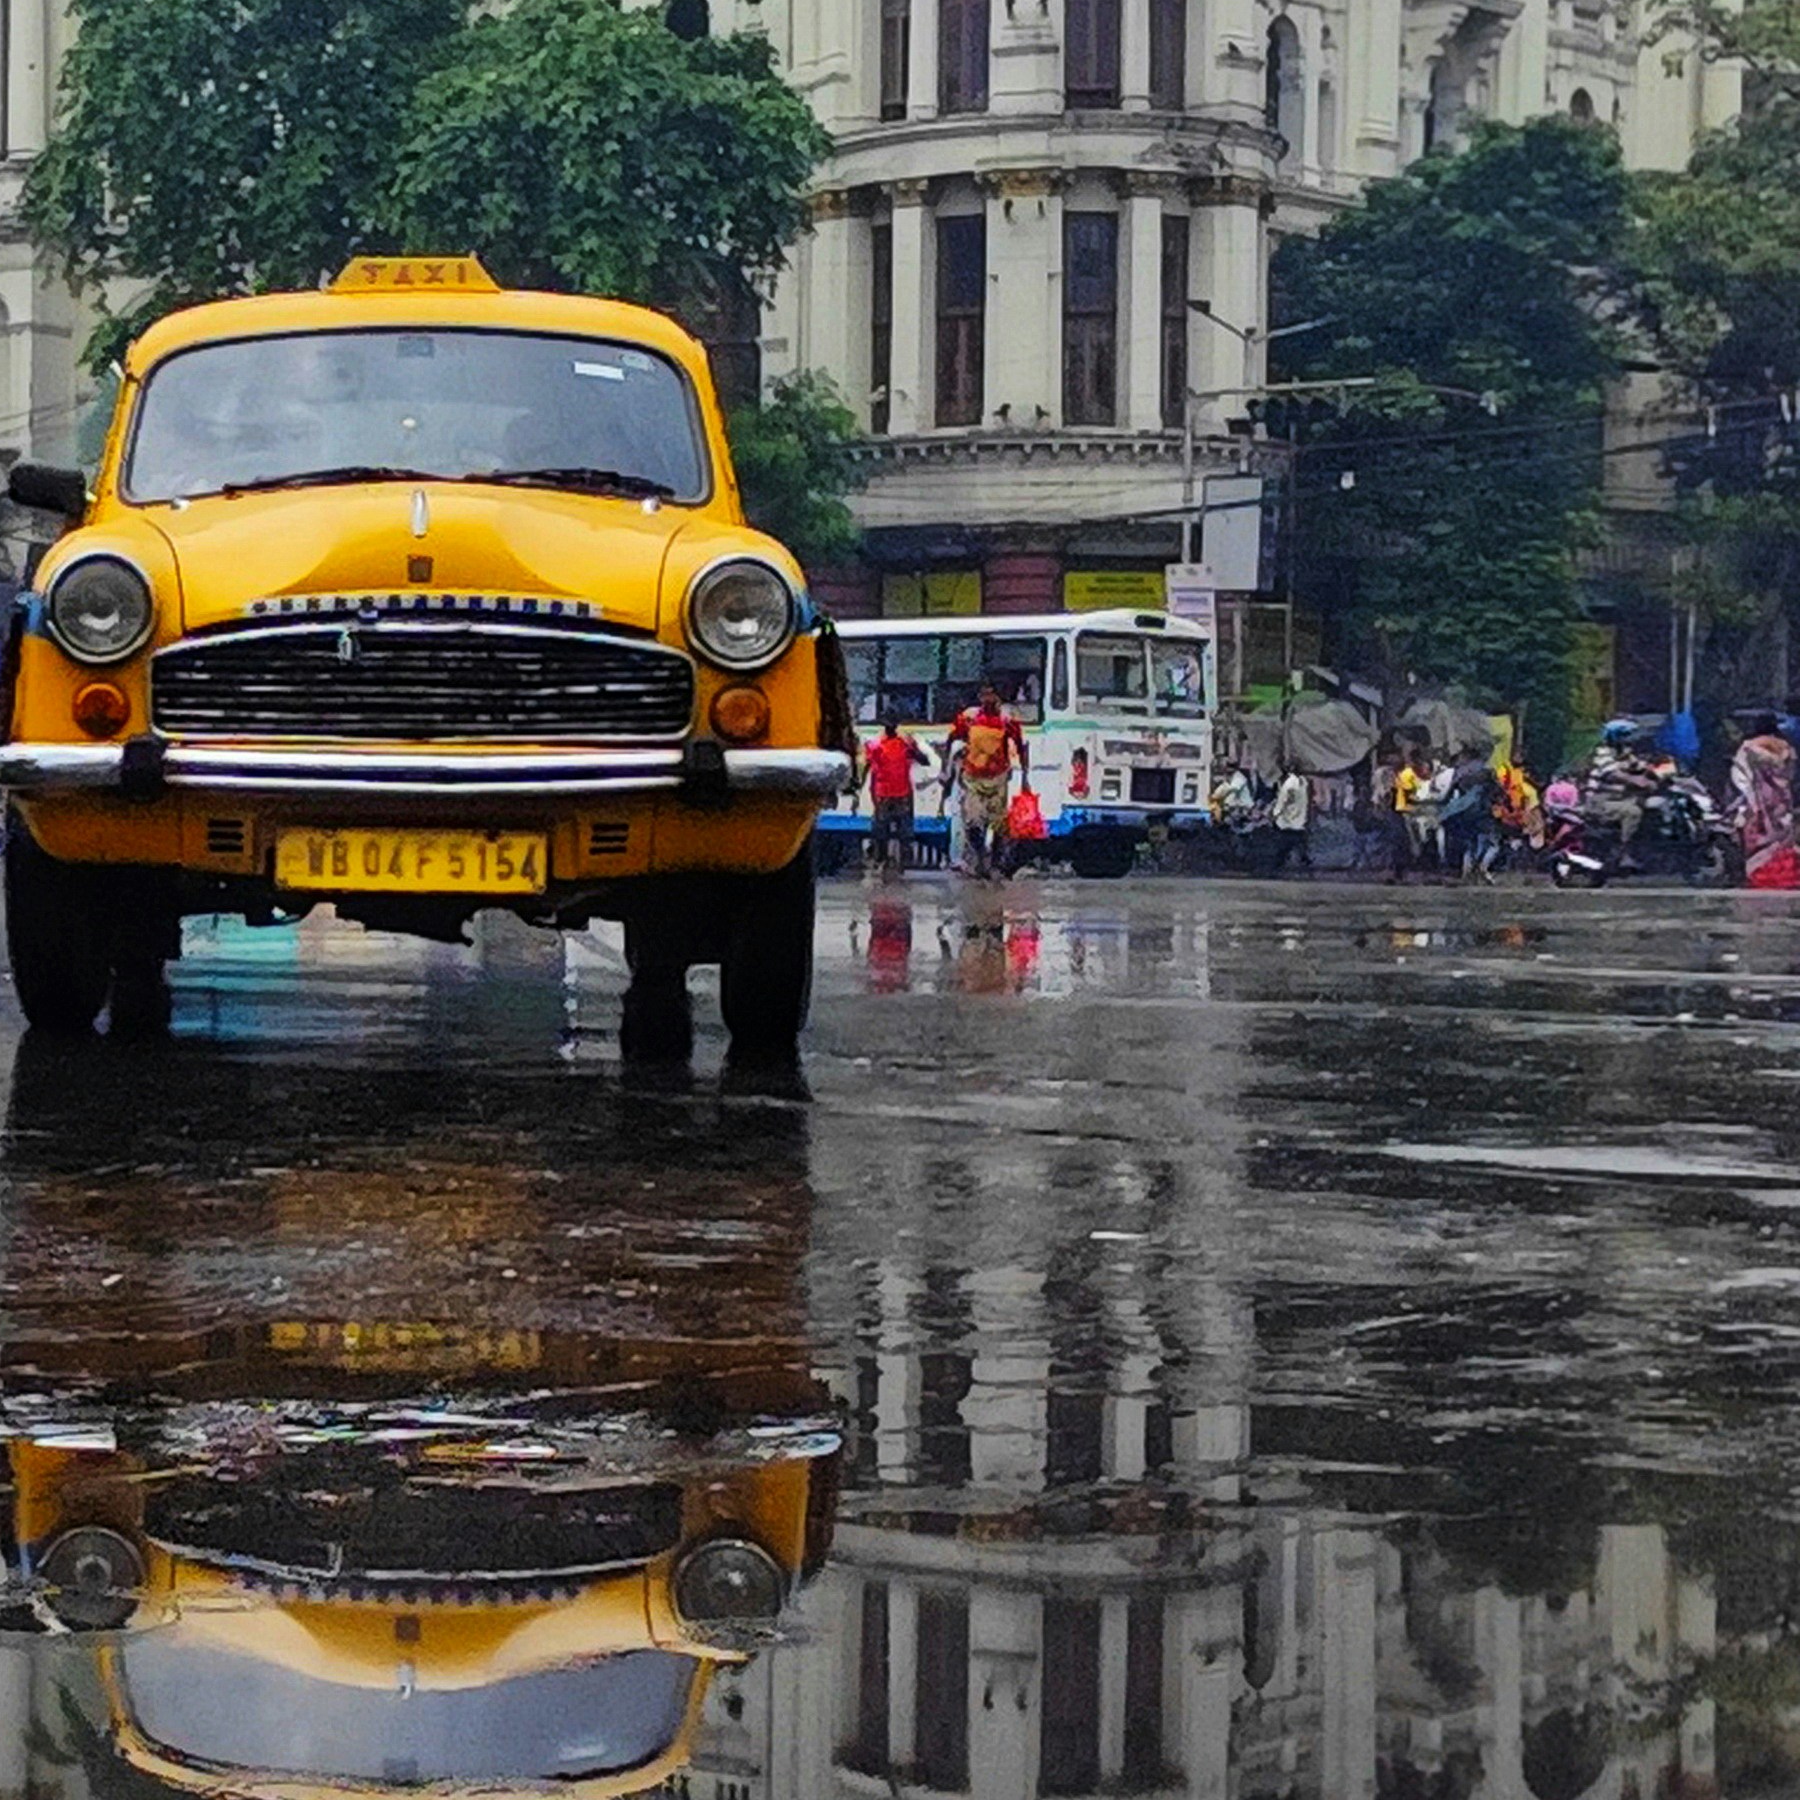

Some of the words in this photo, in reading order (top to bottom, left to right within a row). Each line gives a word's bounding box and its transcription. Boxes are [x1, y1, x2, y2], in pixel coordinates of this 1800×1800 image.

[361, 262, 467, 285] TAXI
[307, 837, 349, 877] WB
[448, 840, 539, 882] 5154
